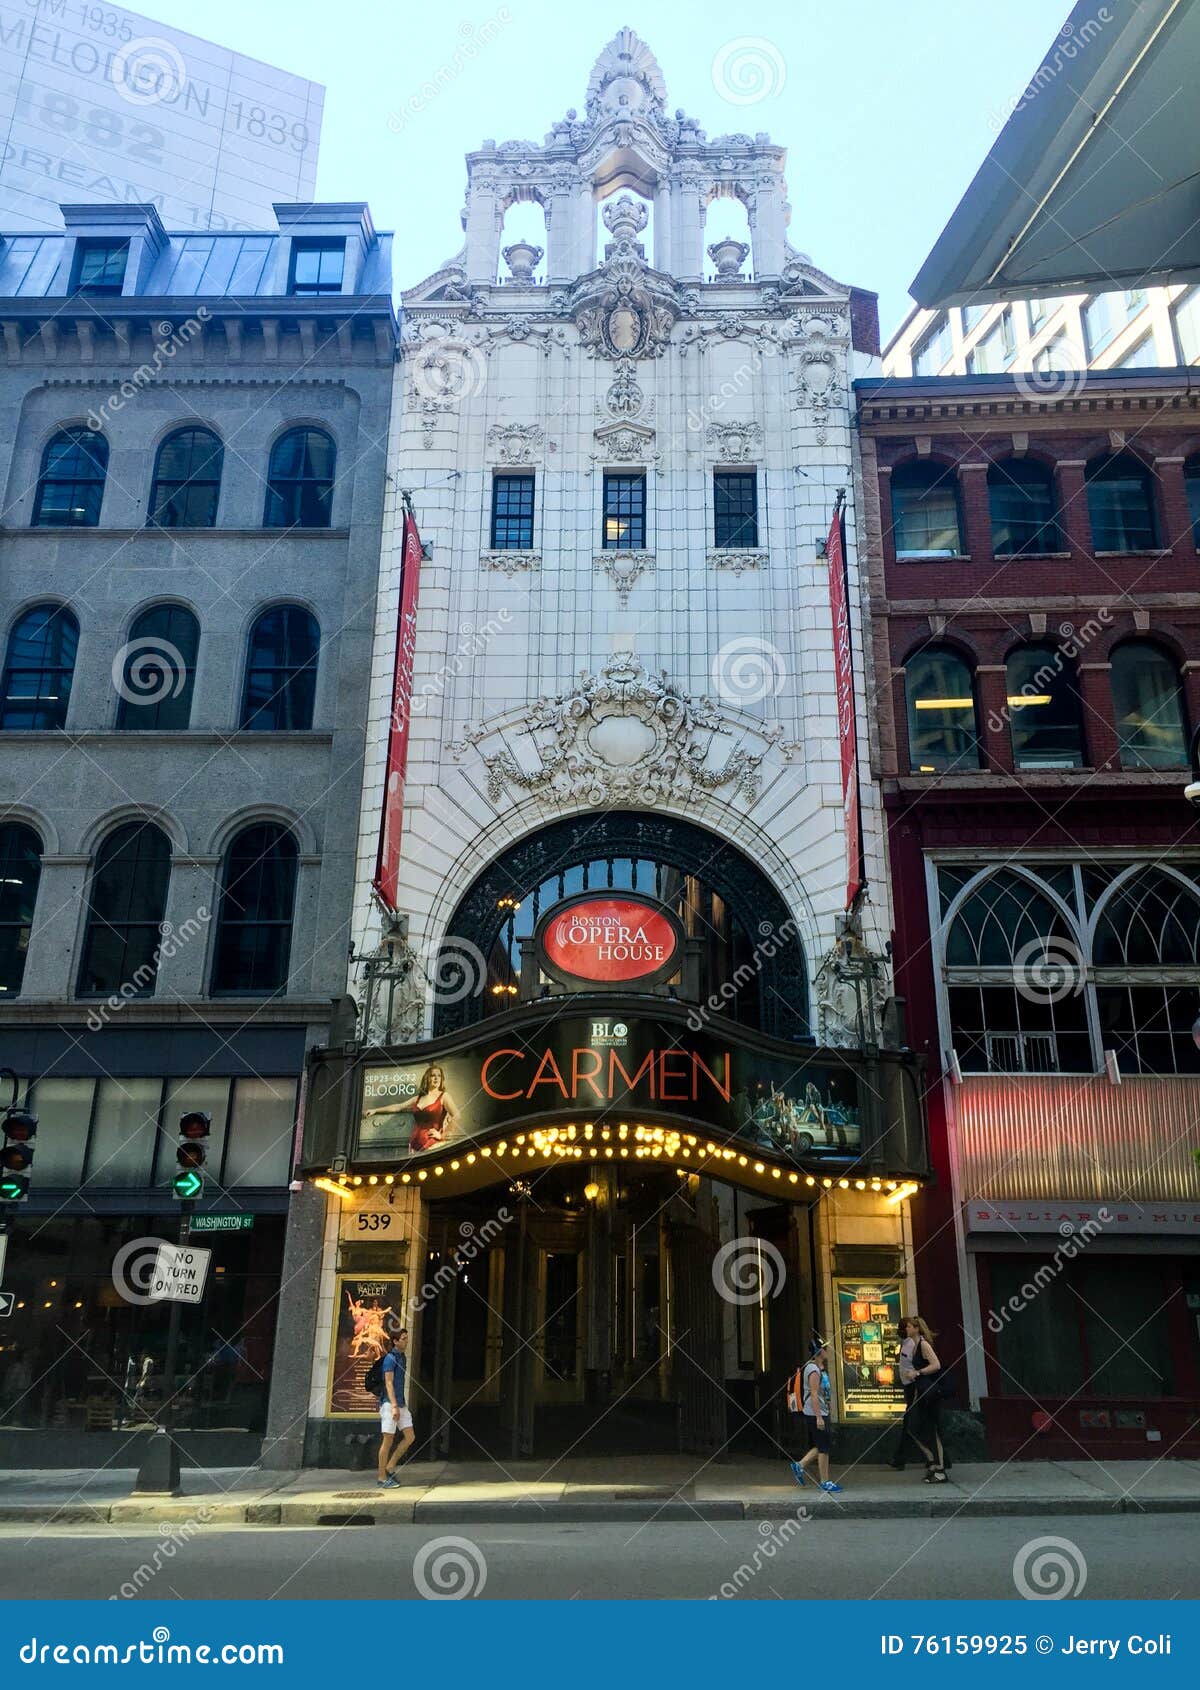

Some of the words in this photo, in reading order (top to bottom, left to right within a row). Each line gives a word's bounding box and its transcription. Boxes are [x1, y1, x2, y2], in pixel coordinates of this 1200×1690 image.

[79, 4, 136, 42] 1935
[8, 83, 166, 165] 1882
[231, 101, 309, 152] 1839
[571, 915, 621, 926] BOSTON
[568, 926, 649, 944] OPERA
[598, 945, 664, 961] HOUSE
[480, 1047, 731, 1104] CARMEN
[365, 1083, 416, 1097] BLO.ORG
[195, 1216, 242, 1228] WASHINGTON
[243, 1218, 252, 1228] ST
[358, 1213, 391, 1231] 539
[174, 1252, 194, 1265] NO
[167, 1266, 197, 1280] TURN
[155, 1280, 172, 1292] ON
[176, 1283, 199, 1295] RED
